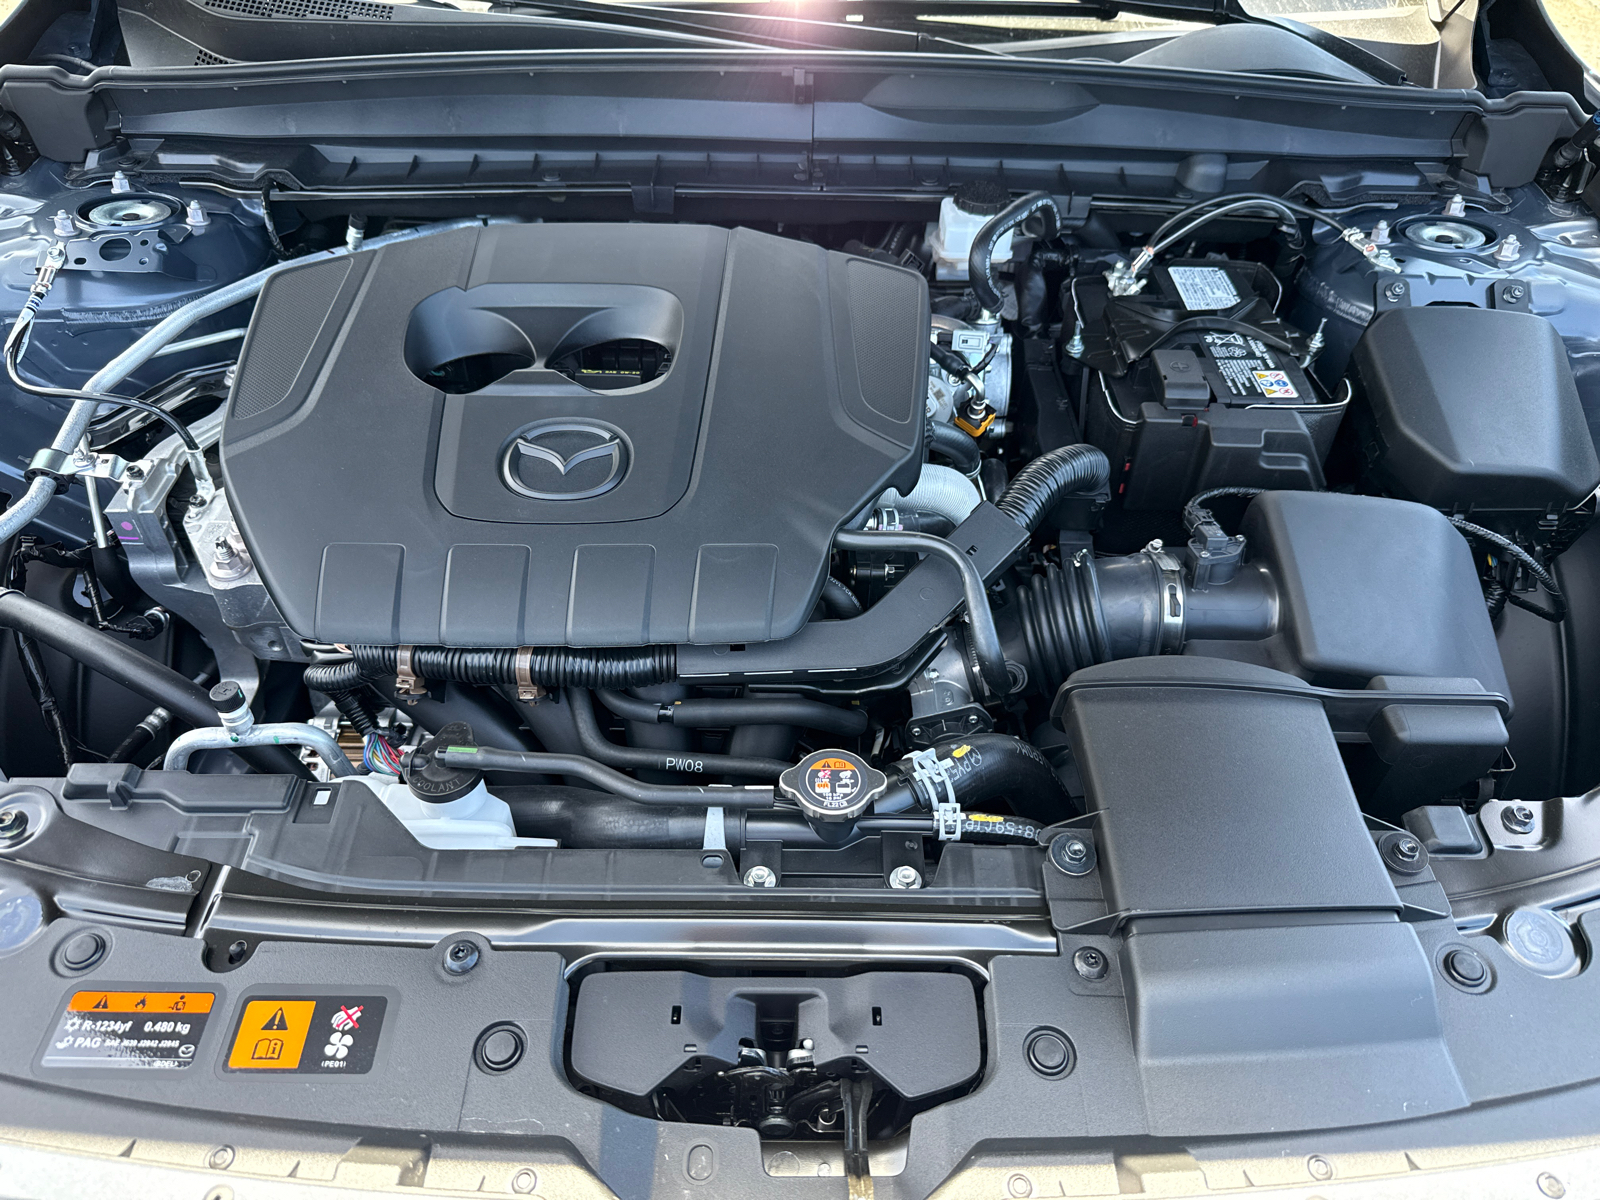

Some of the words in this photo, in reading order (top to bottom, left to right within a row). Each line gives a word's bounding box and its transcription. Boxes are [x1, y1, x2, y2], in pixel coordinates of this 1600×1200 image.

[666, 757, 703, 773] PW08
[412, 776, 461, 792] COOLANT
[82, 1020, 133, 1034] R-1234yf
[143, 1021, 175, 1032] 0.480
[175, 1022, 191, 1035] kg
[74, 1037, 102, 1048] PAG
[321, 1060, 347, 1068] (PE01)
